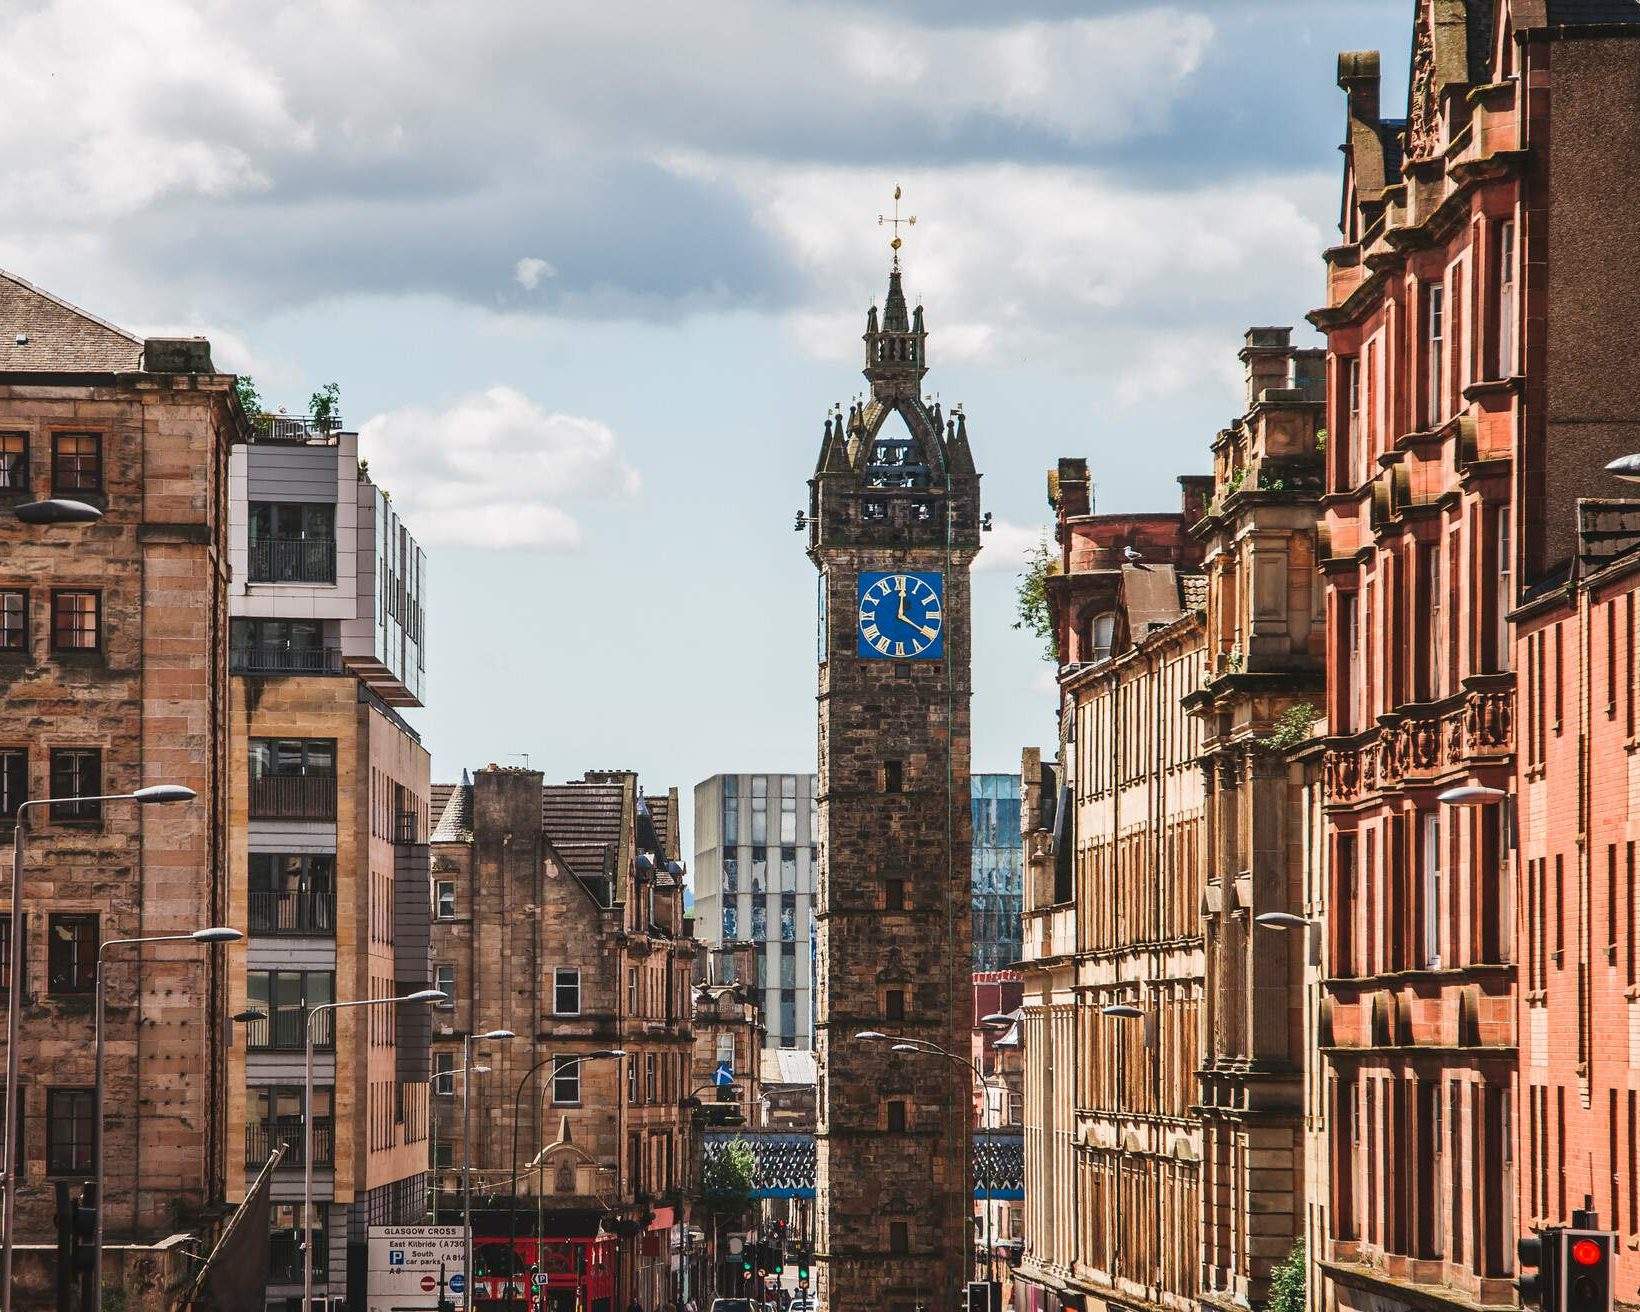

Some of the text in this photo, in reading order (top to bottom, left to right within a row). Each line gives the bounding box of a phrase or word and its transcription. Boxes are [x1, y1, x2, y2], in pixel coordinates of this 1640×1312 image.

[389, 1240, 406, 1248] East
[408, 1240, 436, 1248] Kilbride
[393, 1252, 402, 1264] P
